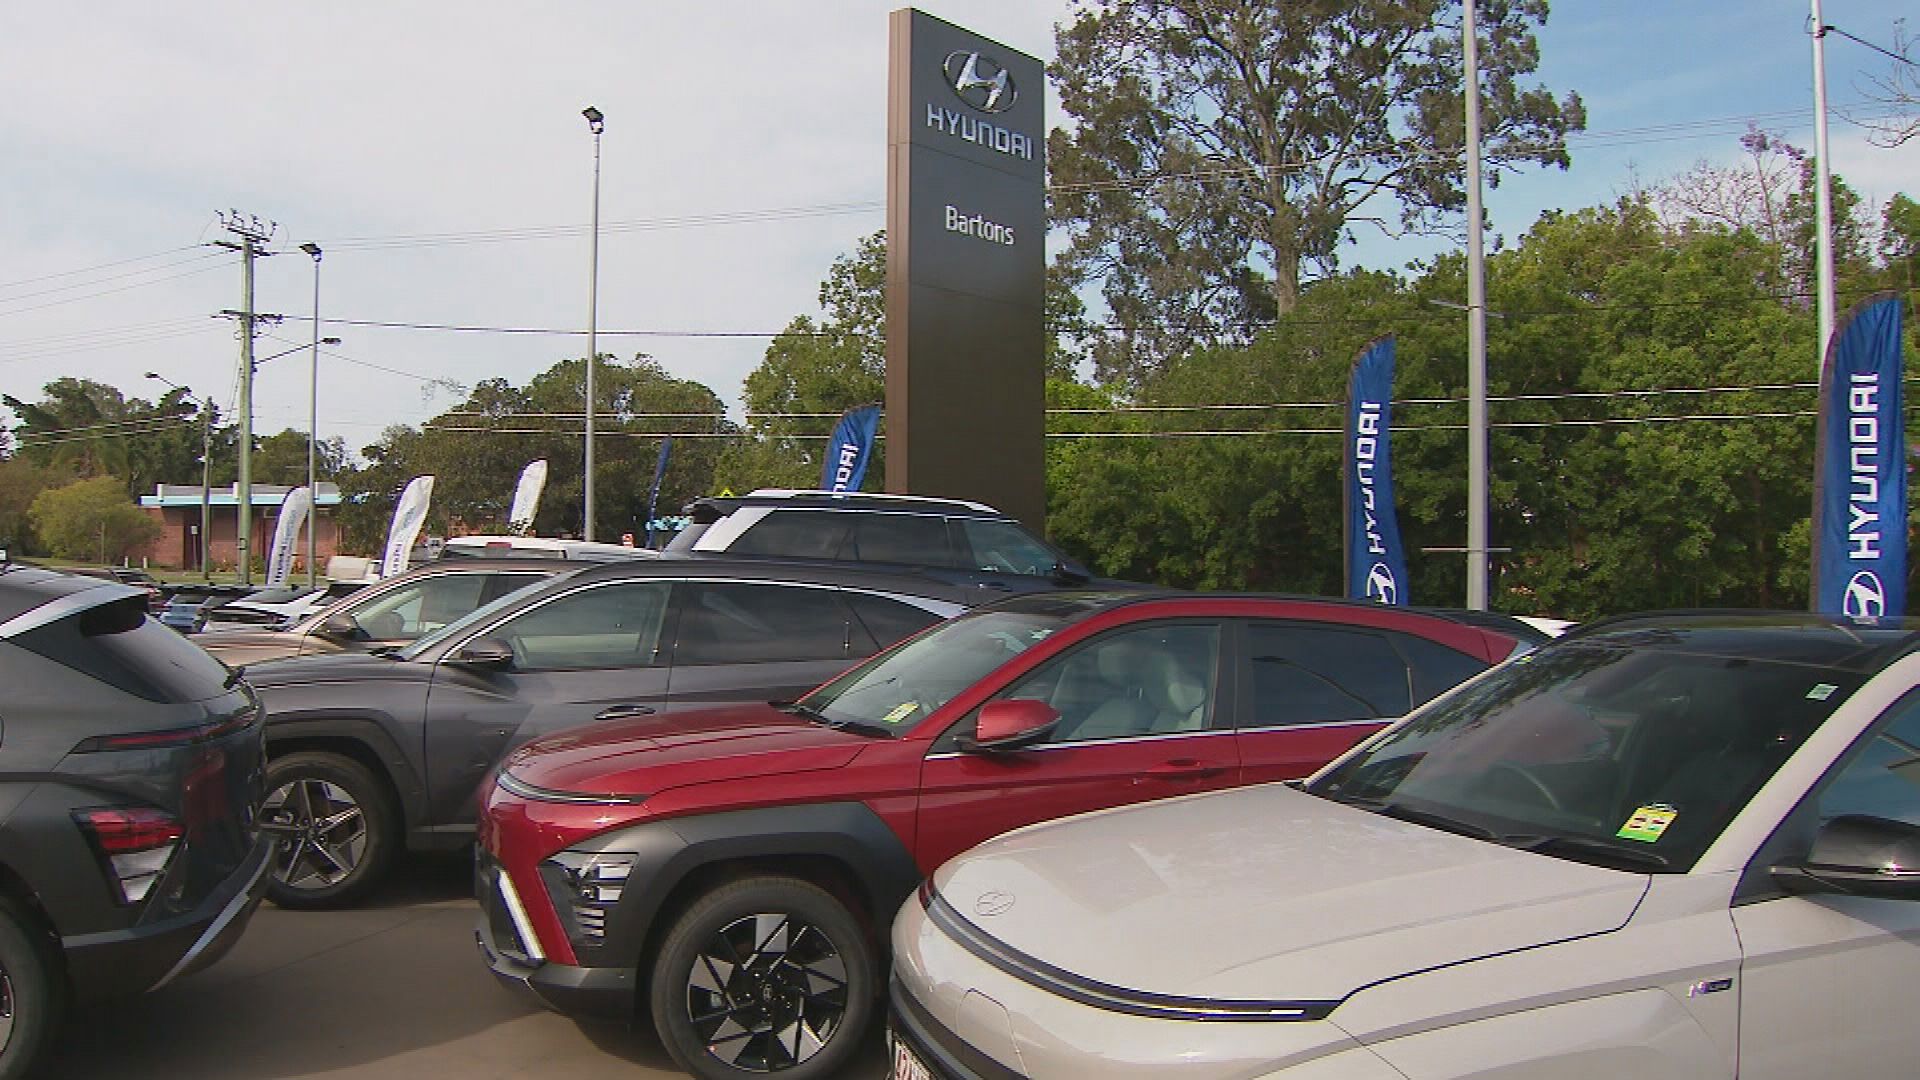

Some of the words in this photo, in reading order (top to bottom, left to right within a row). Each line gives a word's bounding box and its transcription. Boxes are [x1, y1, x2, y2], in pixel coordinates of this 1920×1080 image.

[926, 103, 1033, 161] HYUNDAI
[945, 205, 1014, 245] Bartons
[1849, 373, 1880, 559] HYUNDAI
